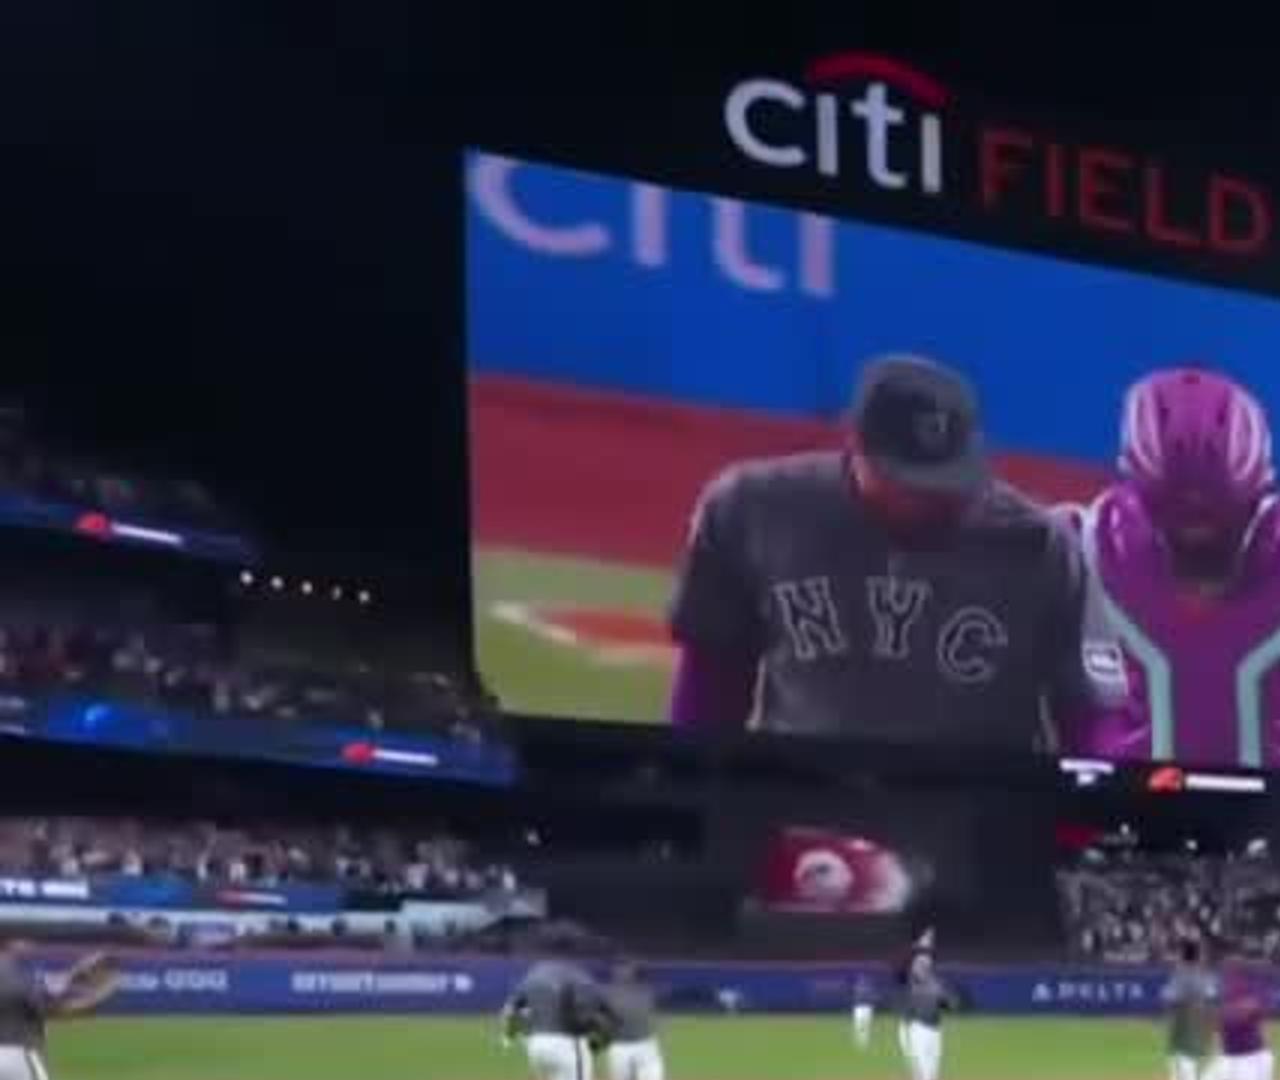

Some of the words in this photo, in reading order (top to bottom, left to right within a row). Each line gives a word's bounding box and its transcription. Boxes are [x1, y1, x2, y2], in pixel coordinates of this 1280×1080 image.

[725, 77, 942, 193] citi
[979, 129, 1273, 255] FIELD
[773, 575, 1008, 683] NYC
